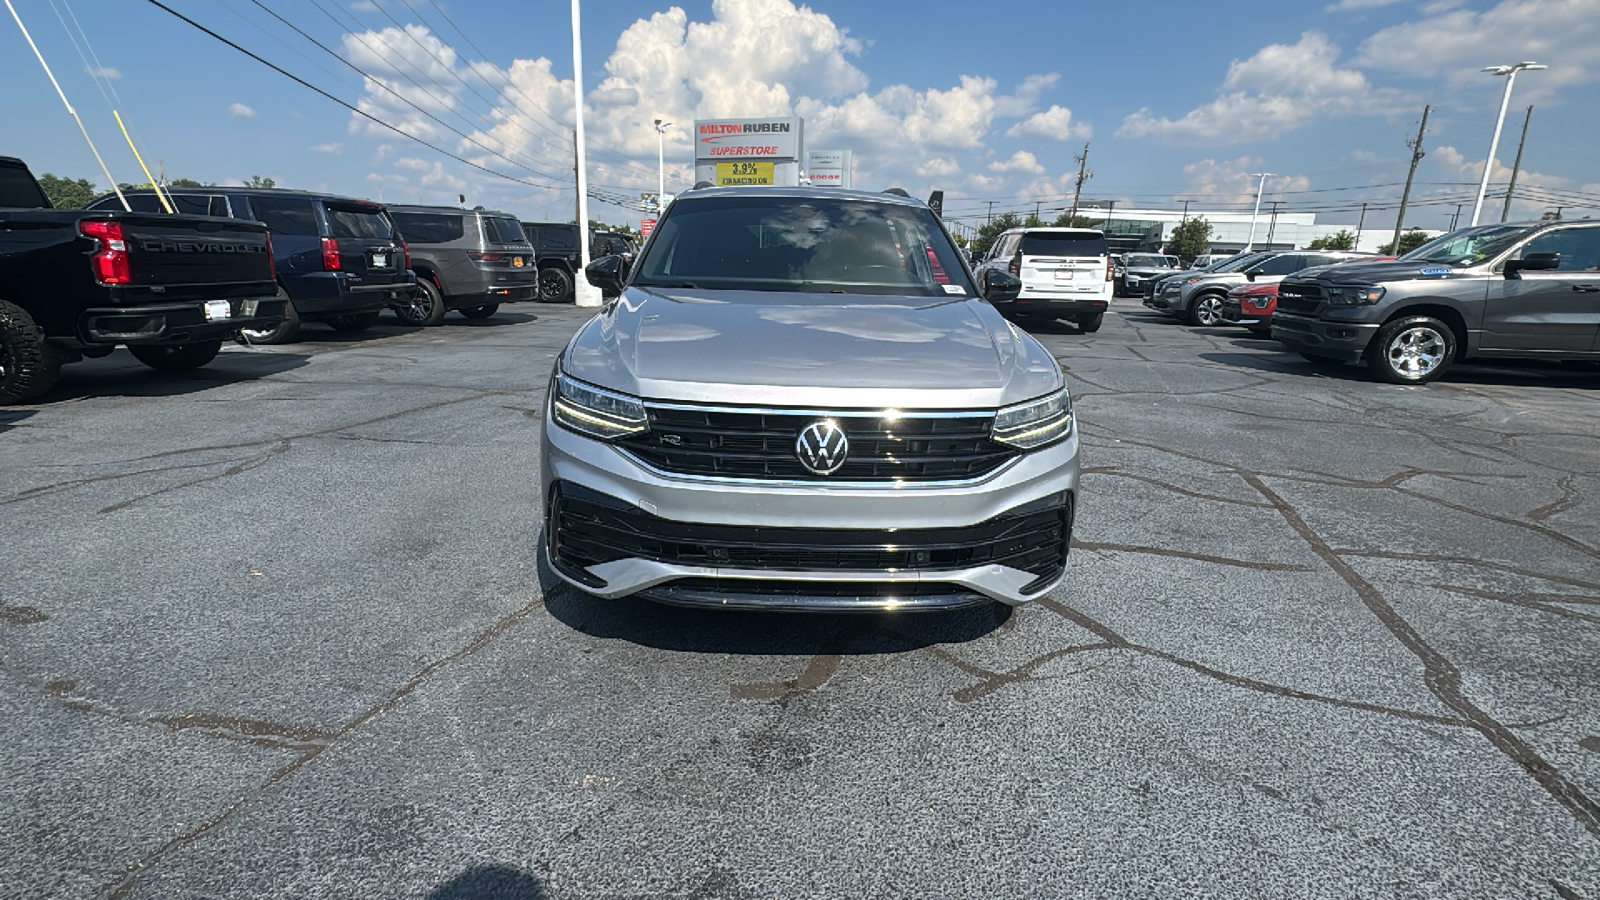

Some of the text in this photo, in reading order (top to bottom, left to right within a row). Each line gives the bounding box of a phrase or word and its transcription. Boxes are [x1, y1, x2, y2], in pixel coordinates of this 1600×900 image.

[700, 123, 790, 133] MILTON RUBEN
[709, 146, 778, 155] SUPERSTORE
[732, 162, 758, 174] 3.9%
[142, 241, 267, 253] CHEVROLET
